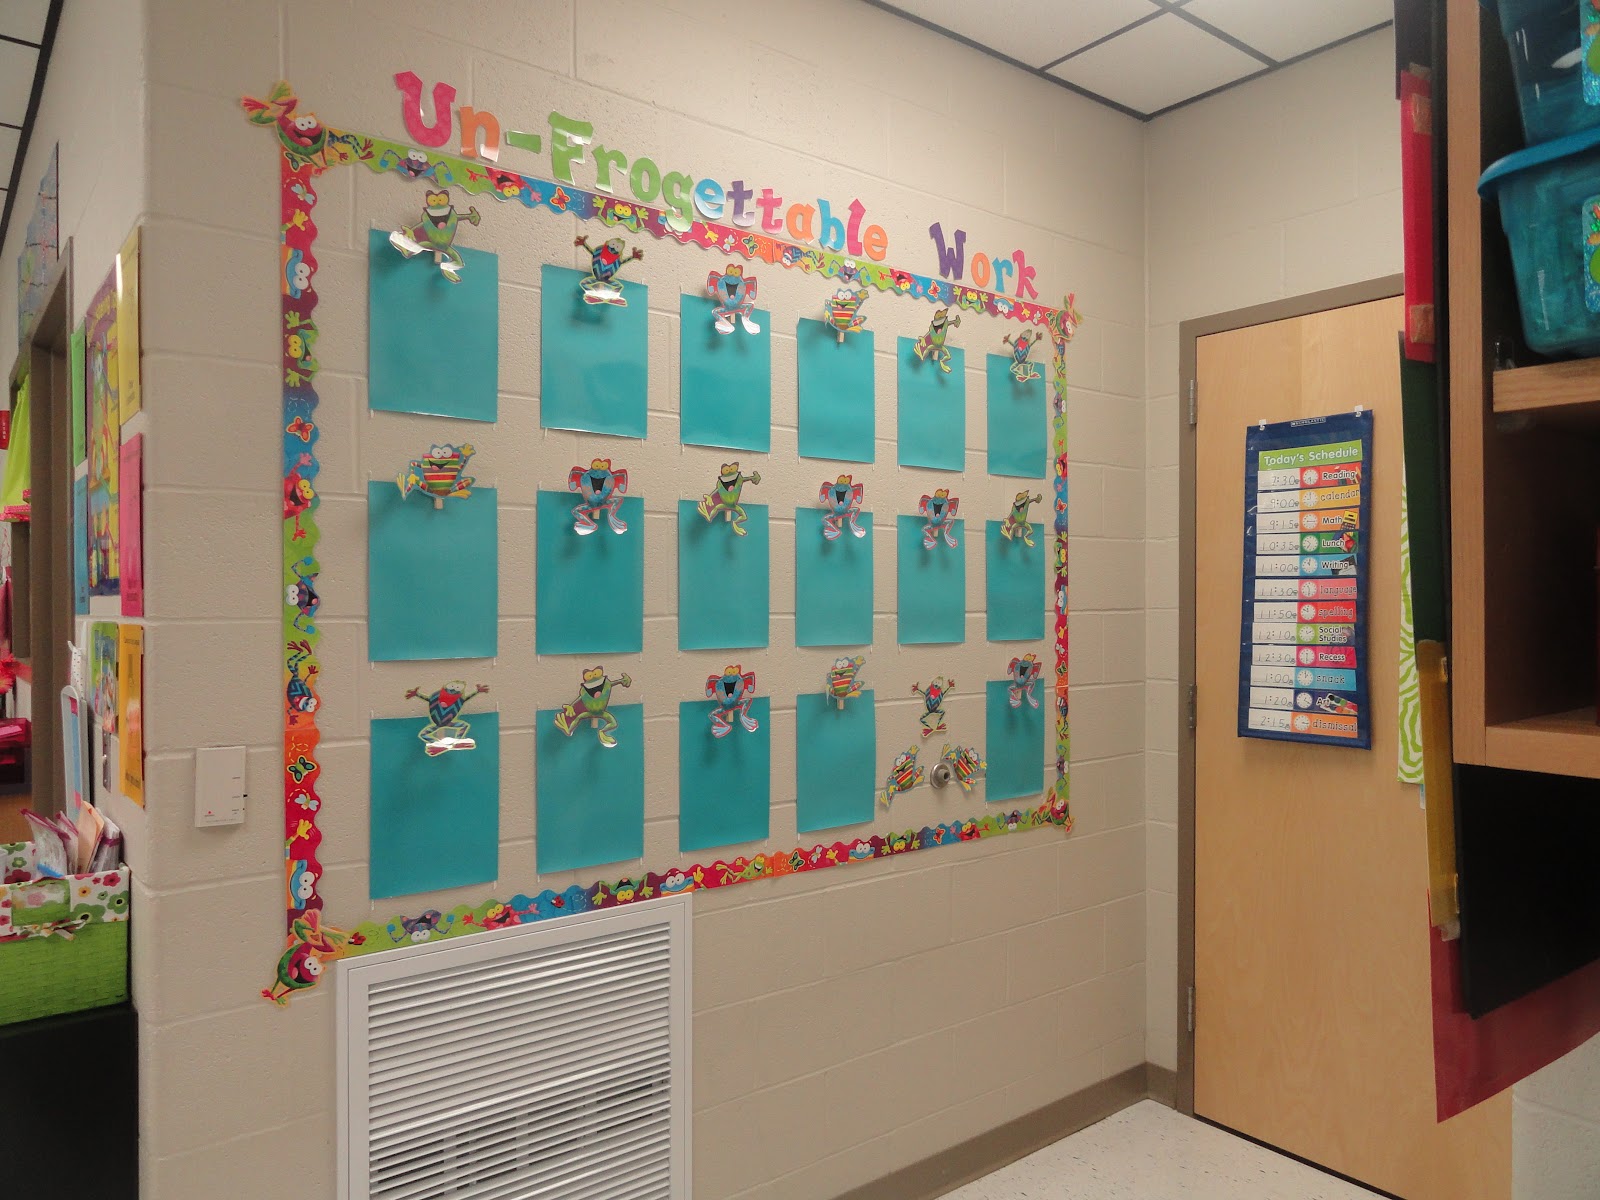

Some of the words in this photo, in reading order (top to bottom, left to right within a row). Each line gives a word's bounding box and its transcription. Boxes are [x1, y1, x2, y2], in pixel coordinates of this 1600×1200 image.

[929, 222, 1039, 299] Work
[1264, 453, 1305, 466] Today's
[1309, 446, 1358, 461] Schedule
[1322, 470, 1356, 481] Reading
[1320, 489, 1360, 502] calendar
[1322, 516, 1343, 525] Math
[1322, 538, 1345, 548] Lunch
[1321, 561, 1349, 570] Writing
[1320, 585, 1357, 597] language
[1318, 607, 1353, 619] spelling
[1319, 626, 1343, 634] Social
[1319, 634, 1347, 643] Studies
[1319, 653, 1346, 662] Recess
[1316, 674, 1345, 684] snack
[1316, 697, 1330, 707] Art
[1312, 719, 1358, 732] dismissal
